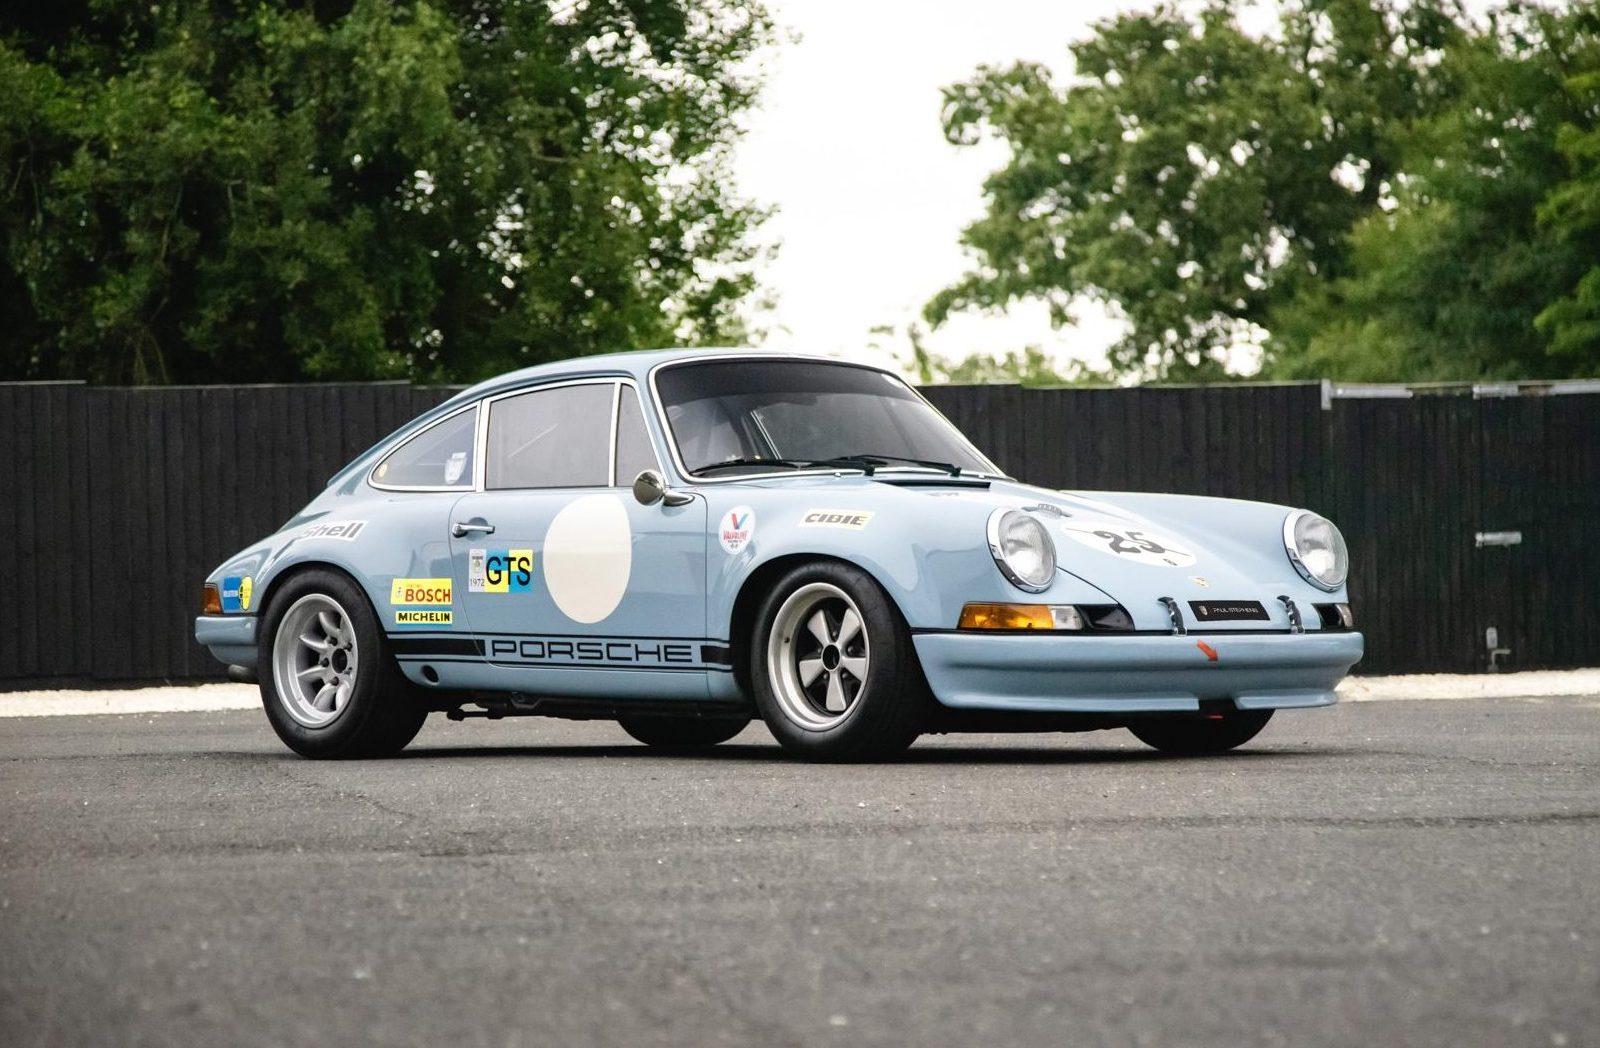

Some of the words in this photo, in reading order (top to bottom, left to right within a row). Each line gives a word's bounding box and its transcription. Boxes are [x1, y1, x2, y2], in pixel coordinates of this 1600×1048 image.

[805, 513, 868, 526] CIBIE
[1093, 530, 1165, 554] 25
[486, 556, 531, 586] GTS
[470, 578, 485, 587] 1972
[405, 588, 451, 602] BOSCH
[398, 612, 451, 621] MICHELIN
[491, 639, 693, 663] PORSCHE
